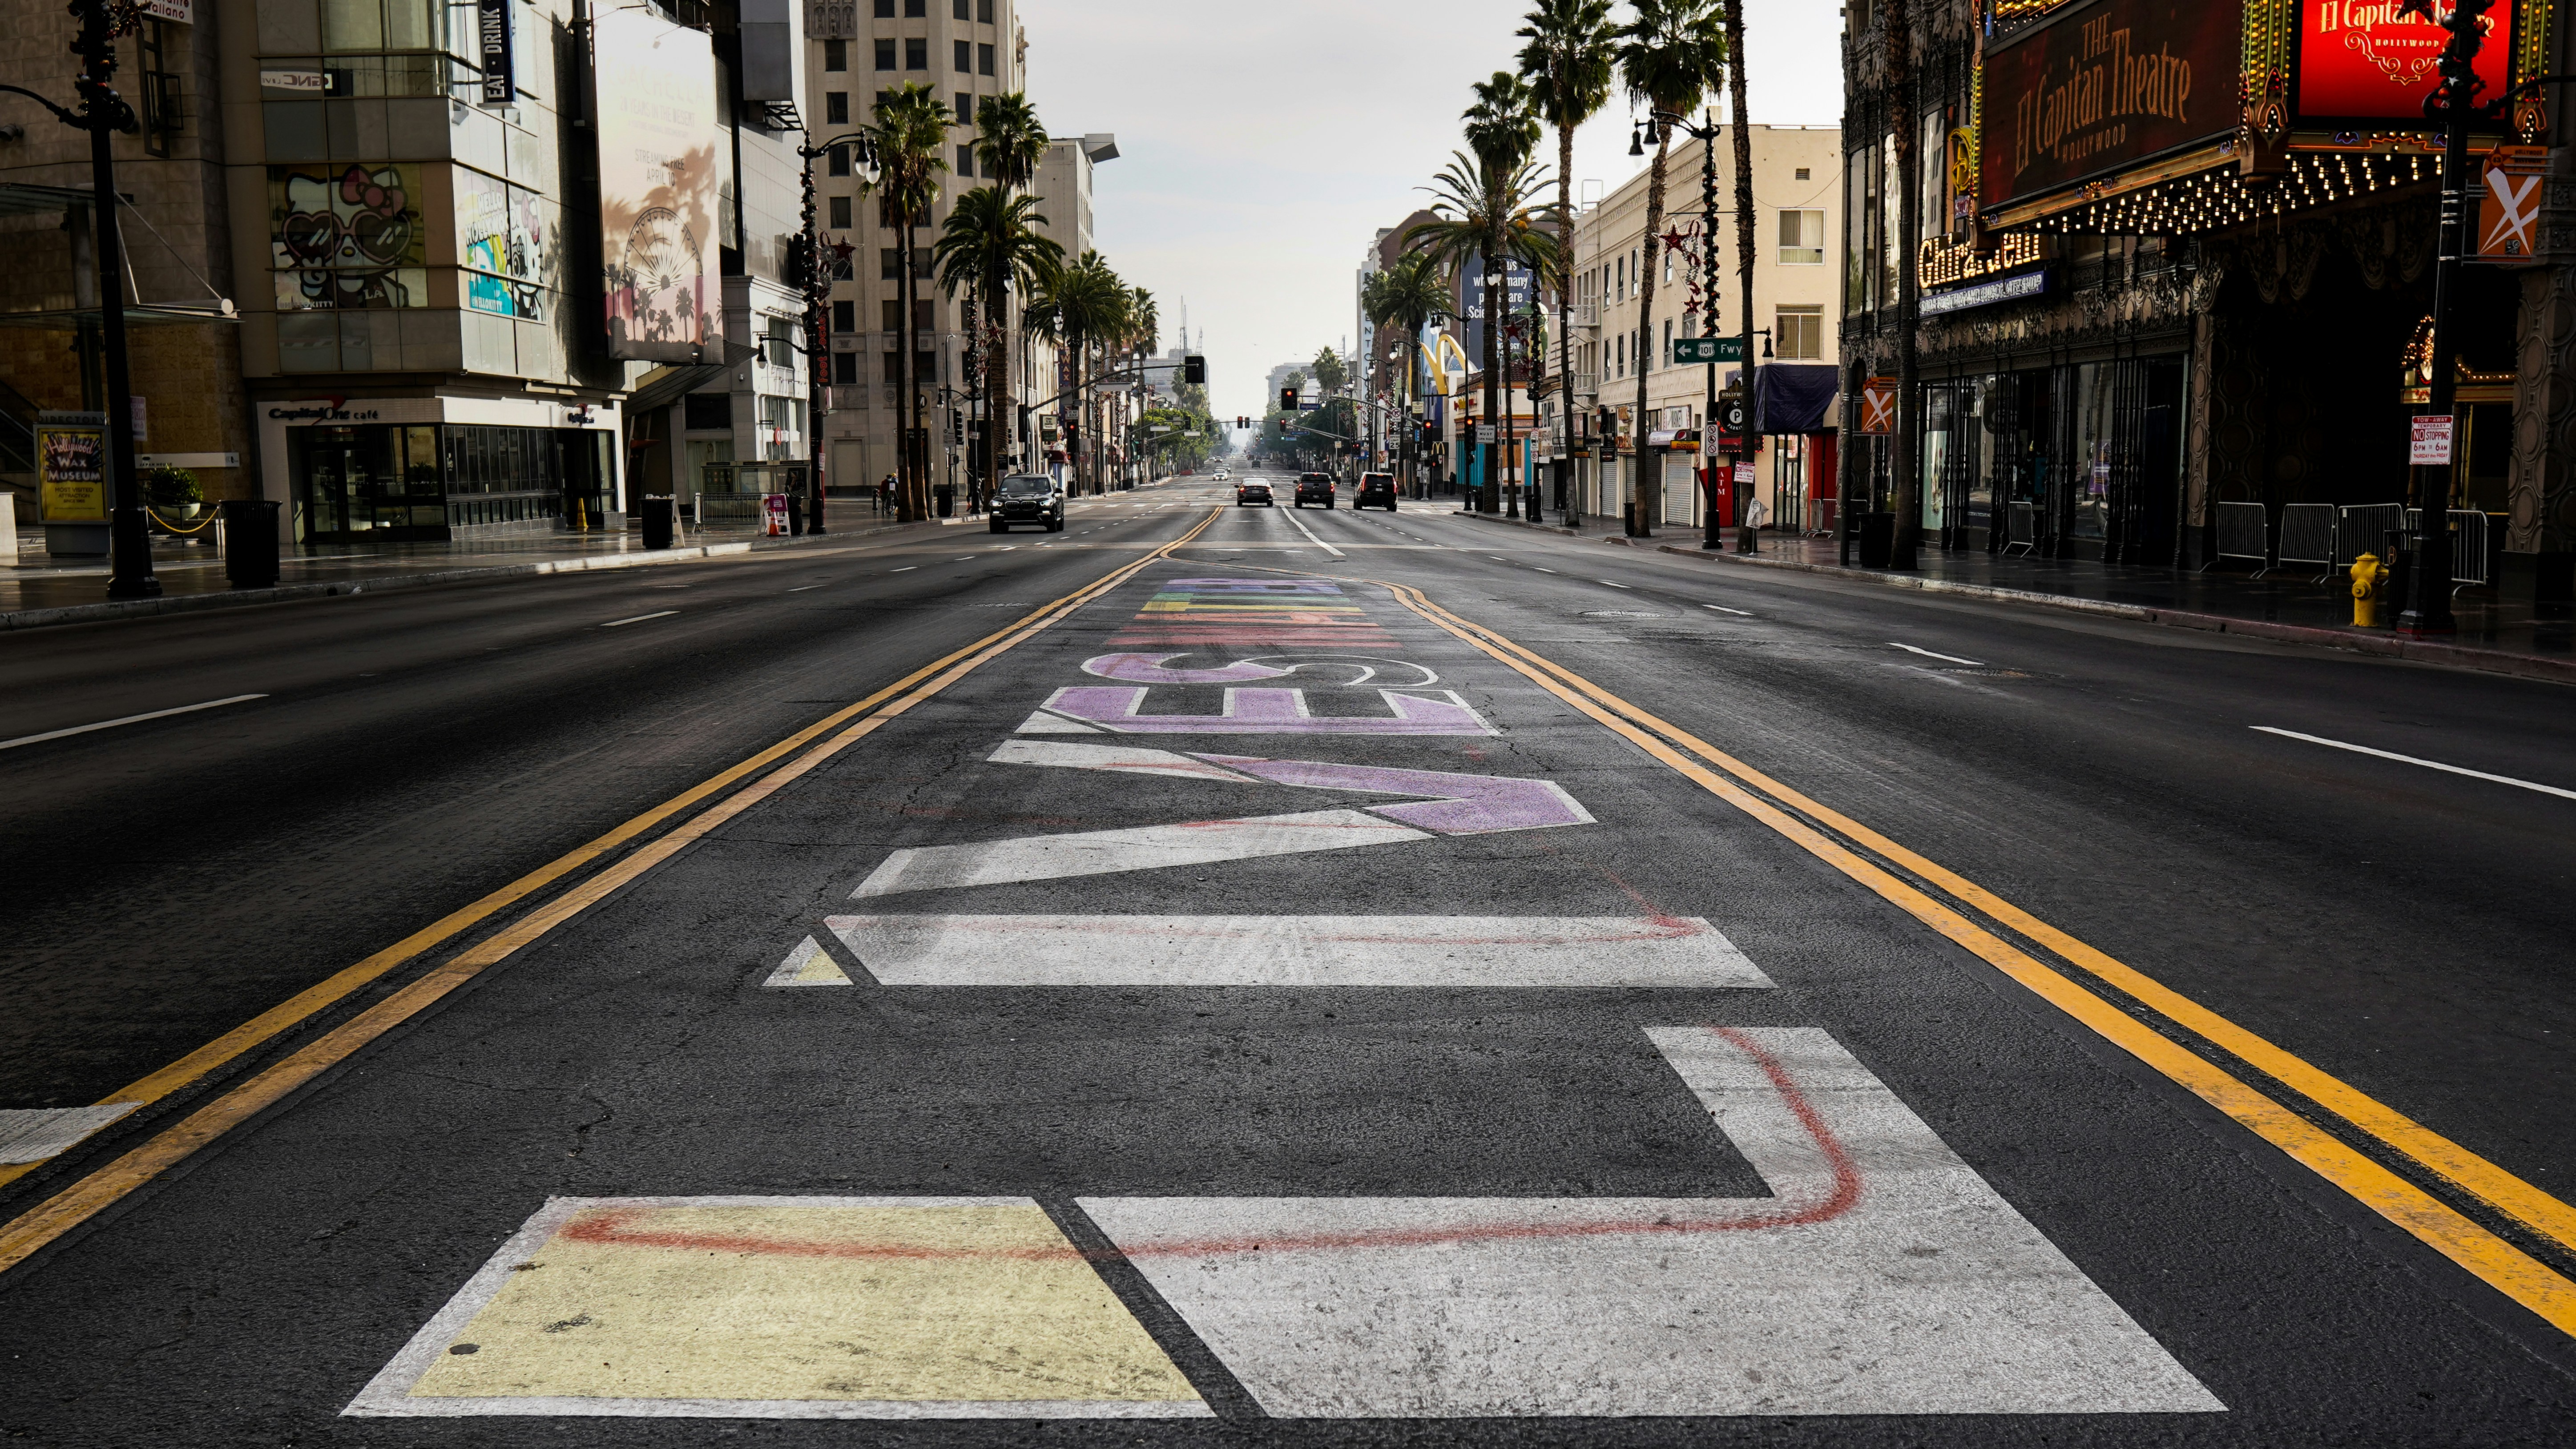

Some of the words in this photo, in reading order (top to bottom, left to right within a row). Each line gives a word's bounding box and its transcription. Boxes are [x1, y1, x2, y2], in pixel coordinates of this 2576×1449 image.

[2320, 1, 2338, 33] El
[482, 8, 502, 53] DRINK
[2082, 12, 2111, 60] THE
[2375, 39, 2439, 47] HOLLYWOOD
[486, 72, 505, 98] EAT
[2015, 90, 2031, 178] El
[2036, 56, 2104, 159] Capitan
[2111, 28, 2191, 123] Theatre
[2063, 123, 2125, 164] HOLLYWOOD
[635, 149, 669, 167] STREAMING
[670, 156, 685, 170] FREE
[647, 169, 665, 185] APRIL
[668, 172, 675, 186] 10
[477, 190, 504, 217] HELLO
[1507, 276, 1528, 290] many
[363, 289, 385, 300] LA
[1508, 293, 1523, 303] are
[1721, 344, 1742, 355] Fwy
[354, 410, 378, 419] café
[1734, 411, 1741, 421] P
[2413, 430, 2424, 441] NO
[2426, 431, 2449, 440] STOPPING
[48, 438, 93, 458] Hollywood
[48, 471, 101, 481] MUSEUM
[1717, 471, 1725, 495] ATM
